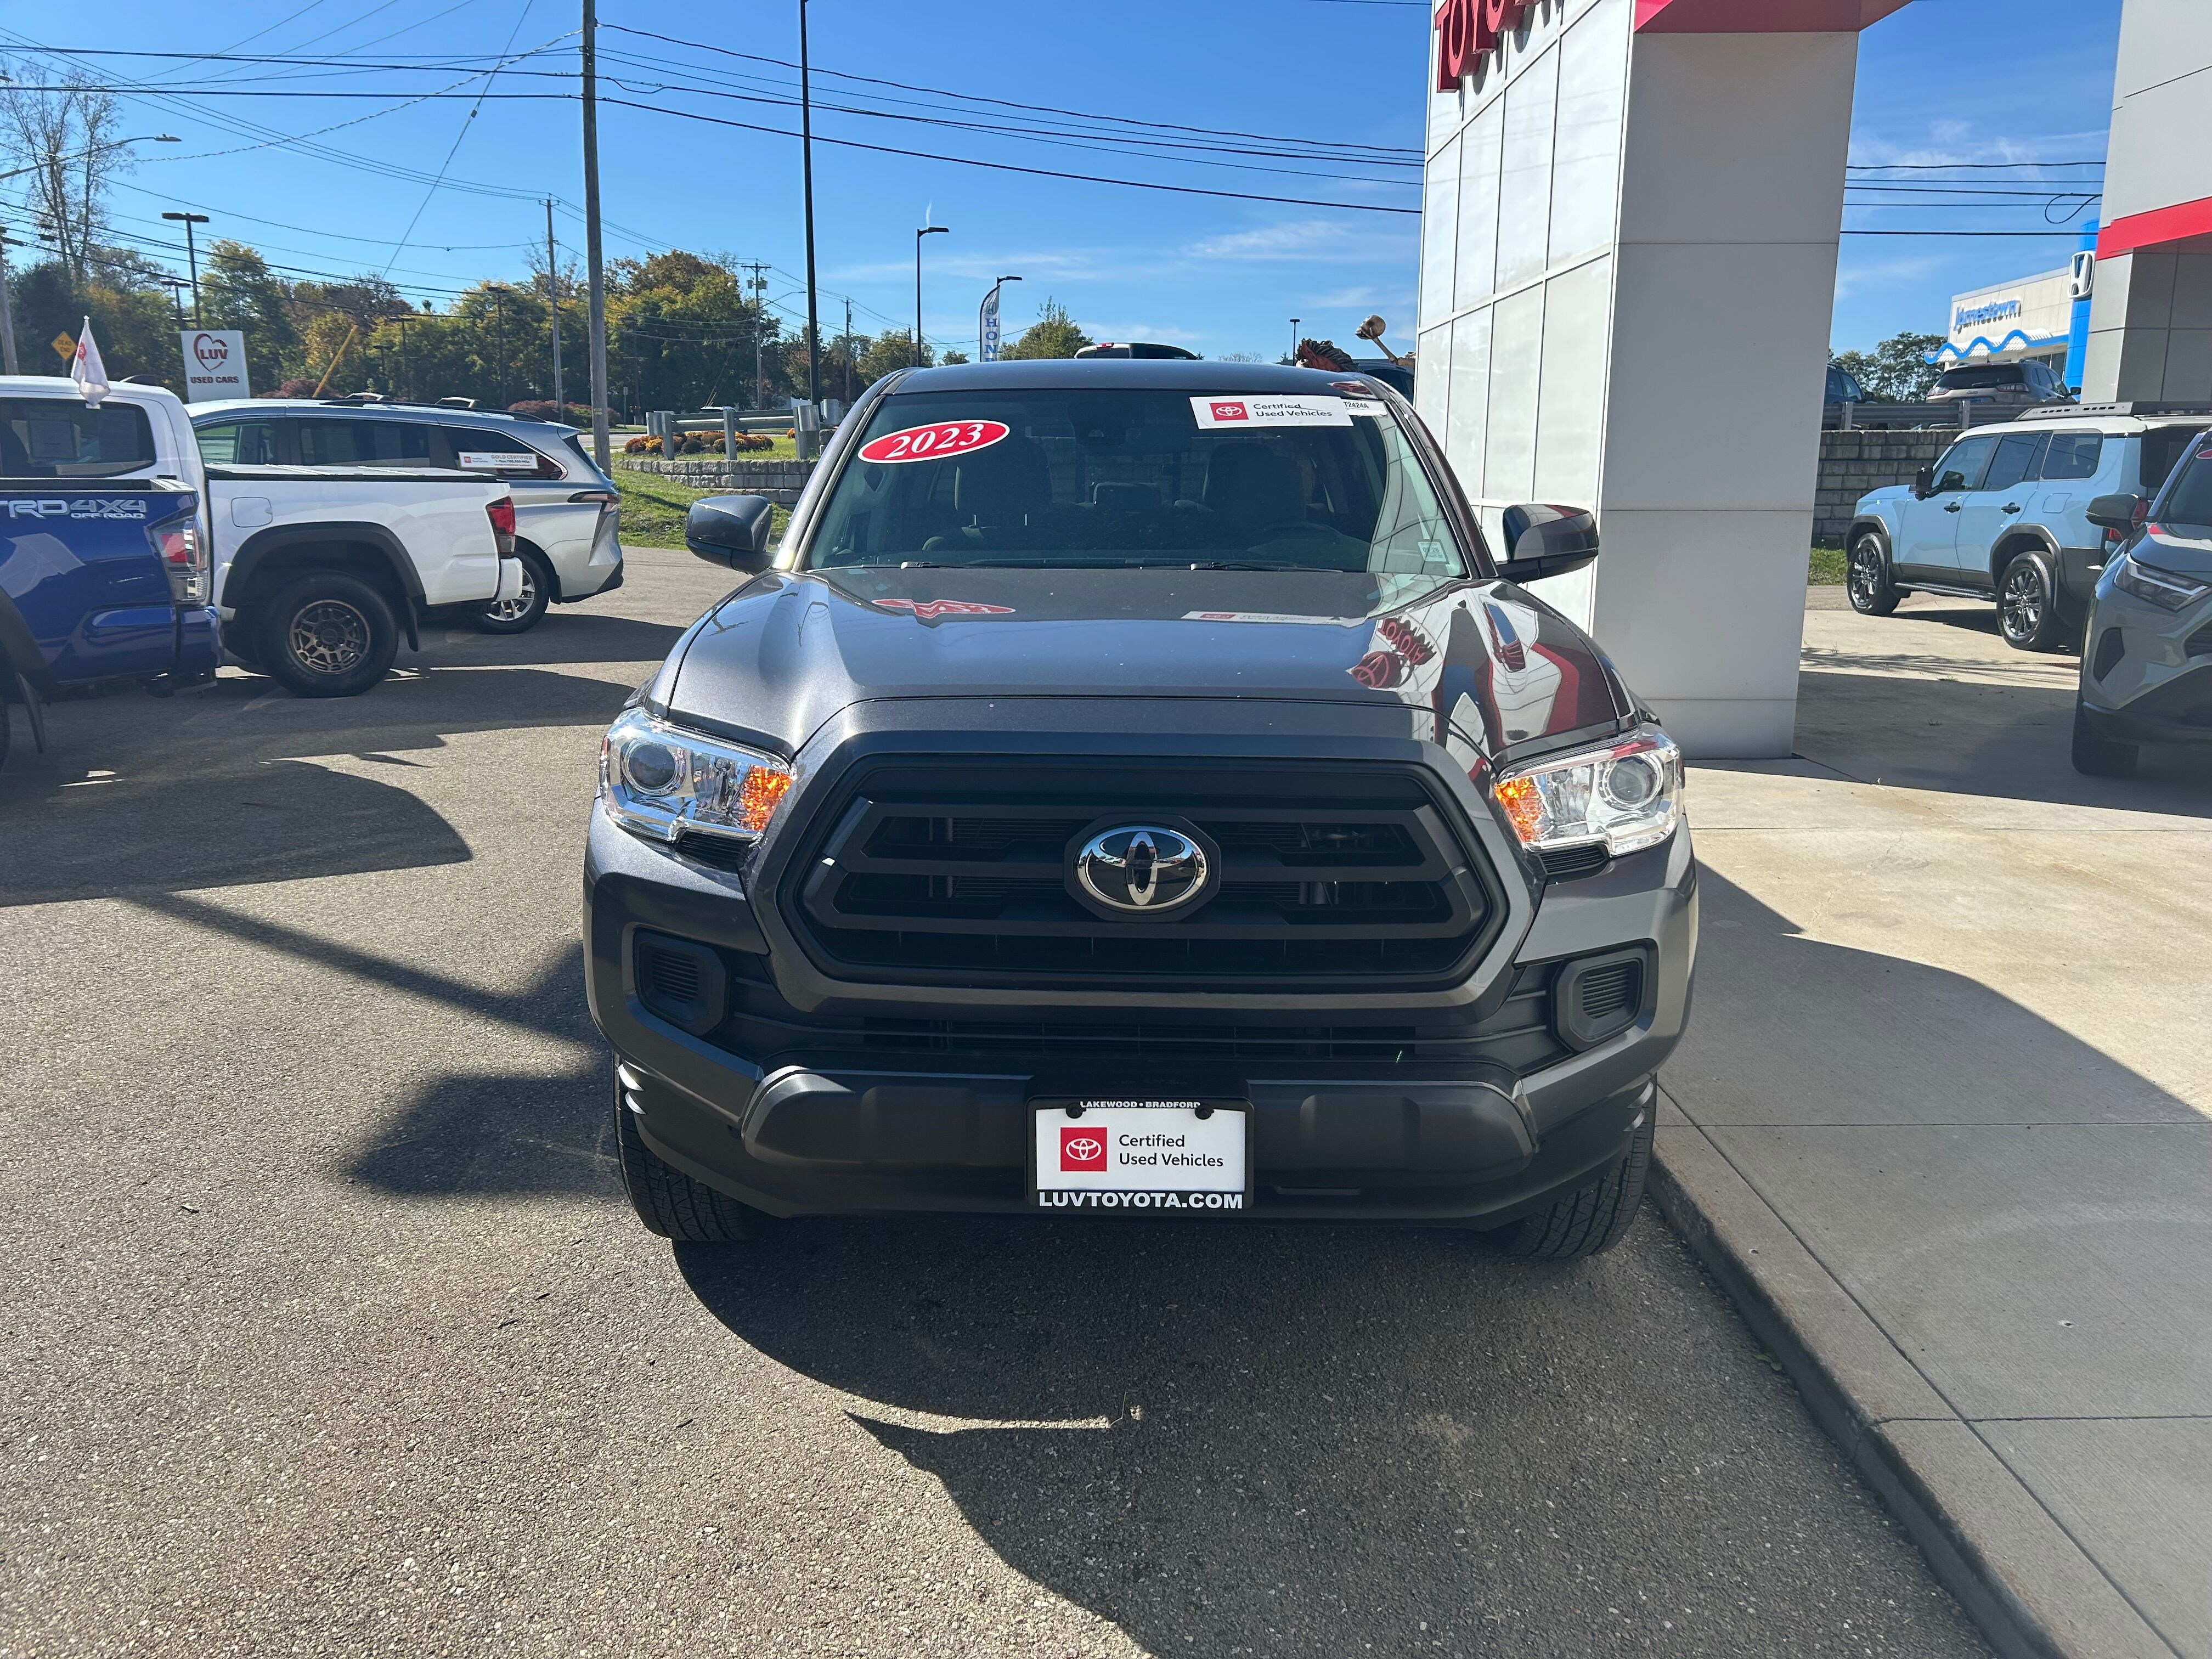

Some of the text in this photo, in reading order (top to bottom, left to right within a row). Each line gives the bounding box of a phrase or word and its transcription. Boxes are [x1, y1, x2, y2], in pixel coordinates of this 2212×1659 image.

[1953, 300, 2017, 331] Jamestown
[199, 349, 228, 359] LUV
[884, 423, 984, 459] 2023
[1119, 1134, 1185, 1147] Certified
[1119, 1153, 1223, 1167] Used Vehicles
[1039, 1192, 1243, 1209] LUVTOYOTA.COM
